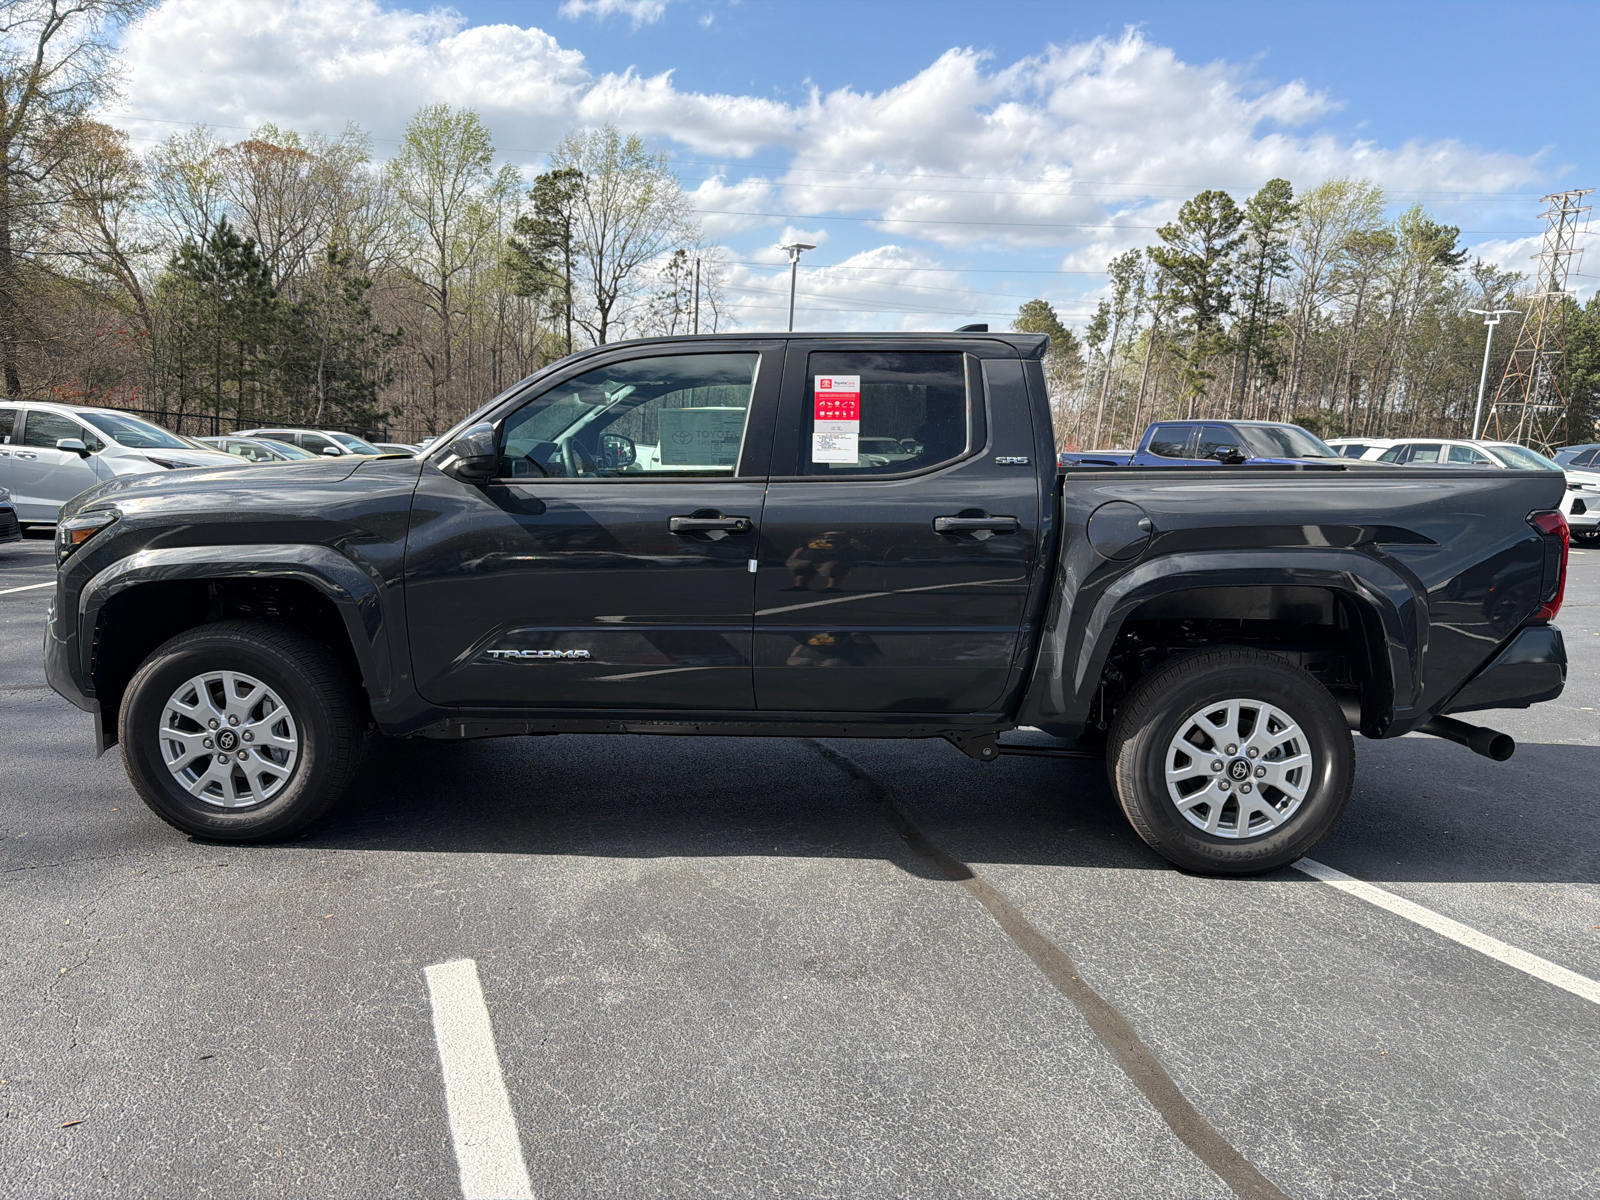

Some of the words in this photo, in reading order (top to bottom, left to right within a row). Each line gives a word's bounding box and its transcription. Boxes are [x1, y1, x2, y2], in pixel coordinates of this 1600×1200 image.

[695, 430, 737, 439] TOYOTA
[995, 456, 1029, 464] SR5
[486, 649, 591, 659] TACOMA
